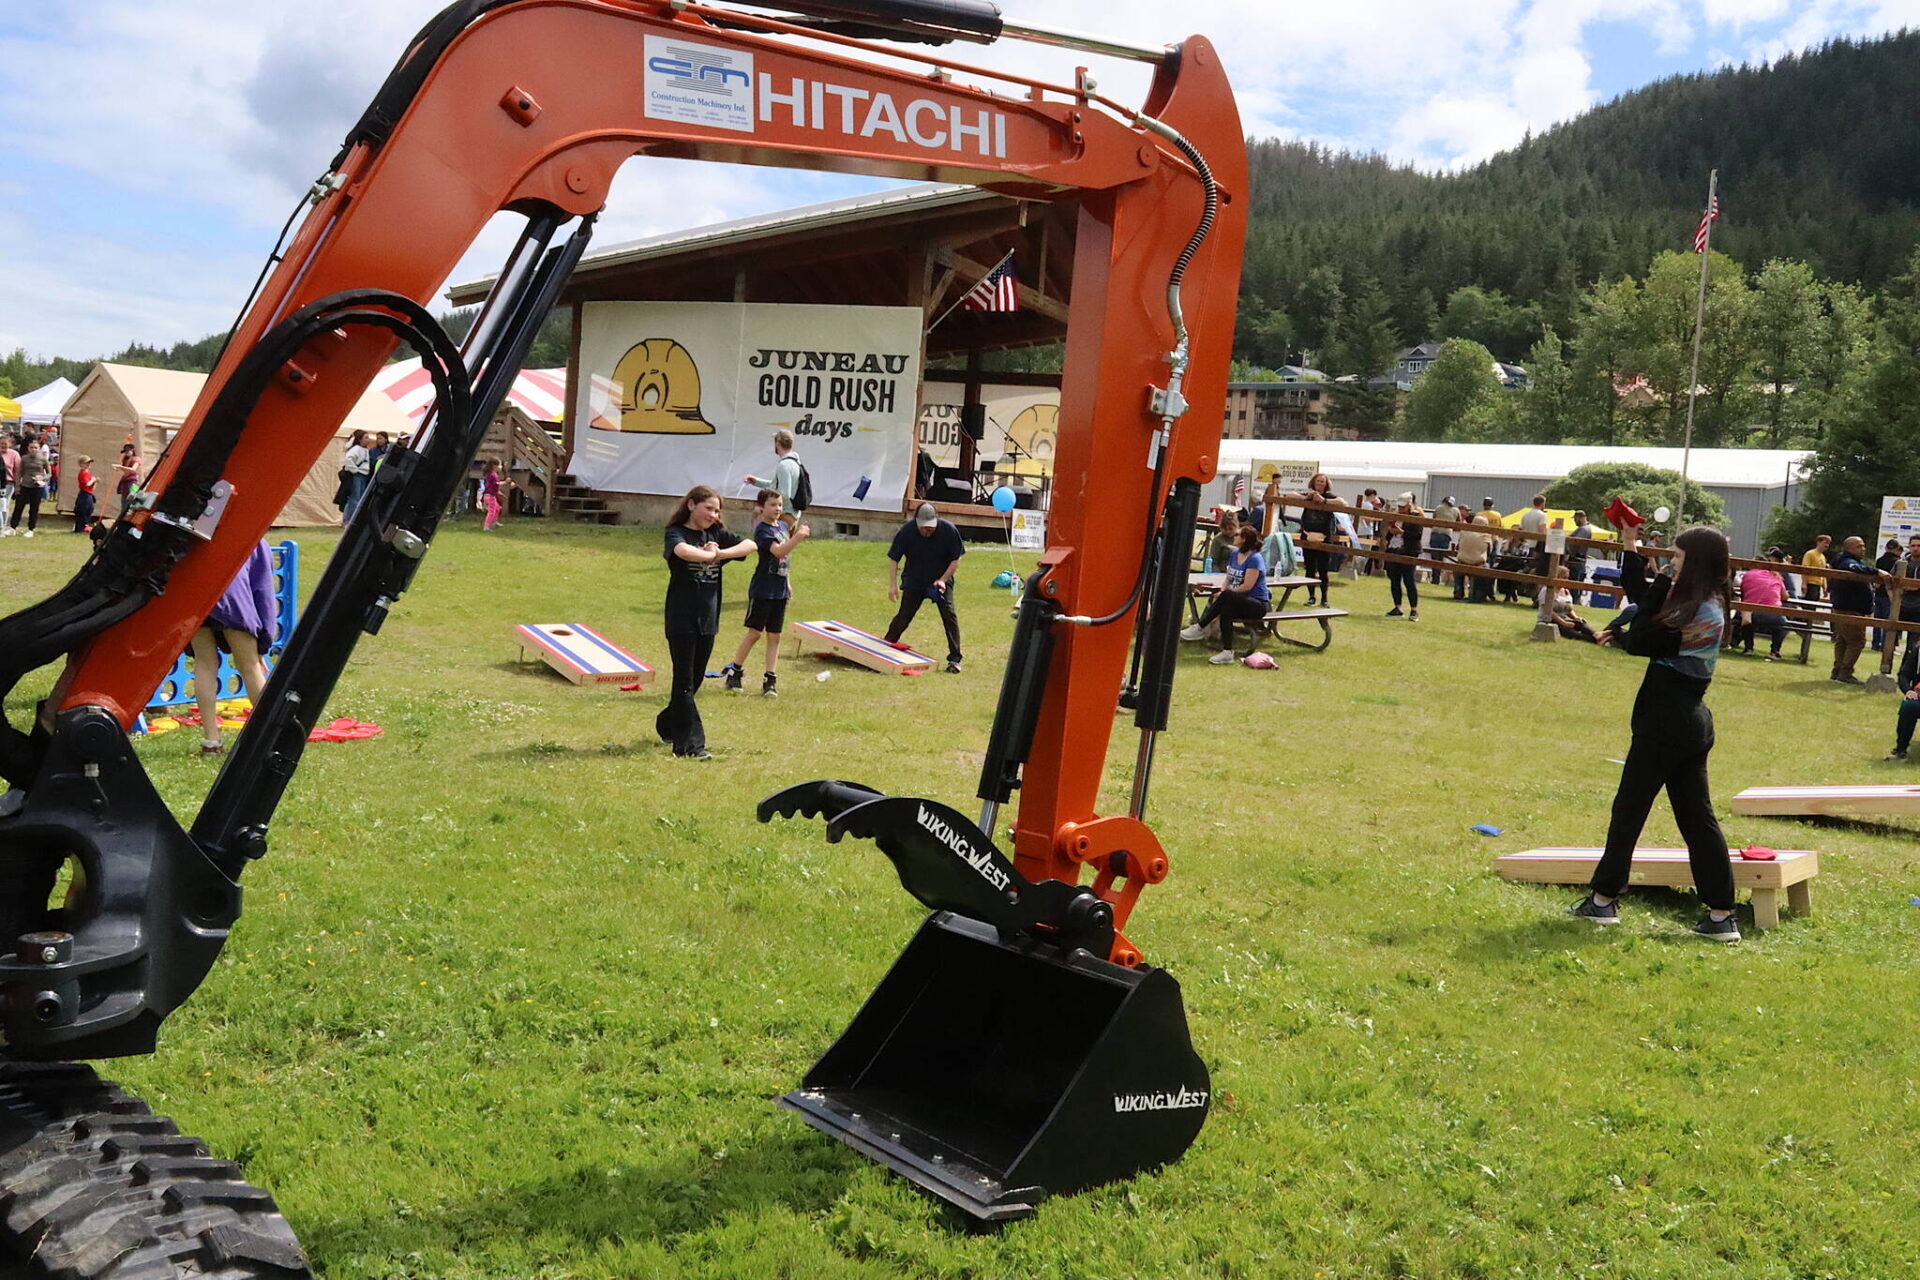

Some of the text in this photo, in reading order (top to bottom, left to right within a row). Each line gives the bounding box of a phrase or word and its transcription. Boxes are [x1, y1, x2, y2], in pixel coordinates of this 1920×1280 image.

[651, 91, 695, 104] Construction
[697, 97, 732, 111] Machinery
[759, 72, 1006, 158] HITACHI
[749, 349, 910, 374] JUNEAU
[759, 374, 896, 413] GOLD RUSH
[795, 413, 853, 443] days
[917, 802, 1010, 891] VIKING WEST
[1114, 1083, 1208, 1112] VIKING WEST
